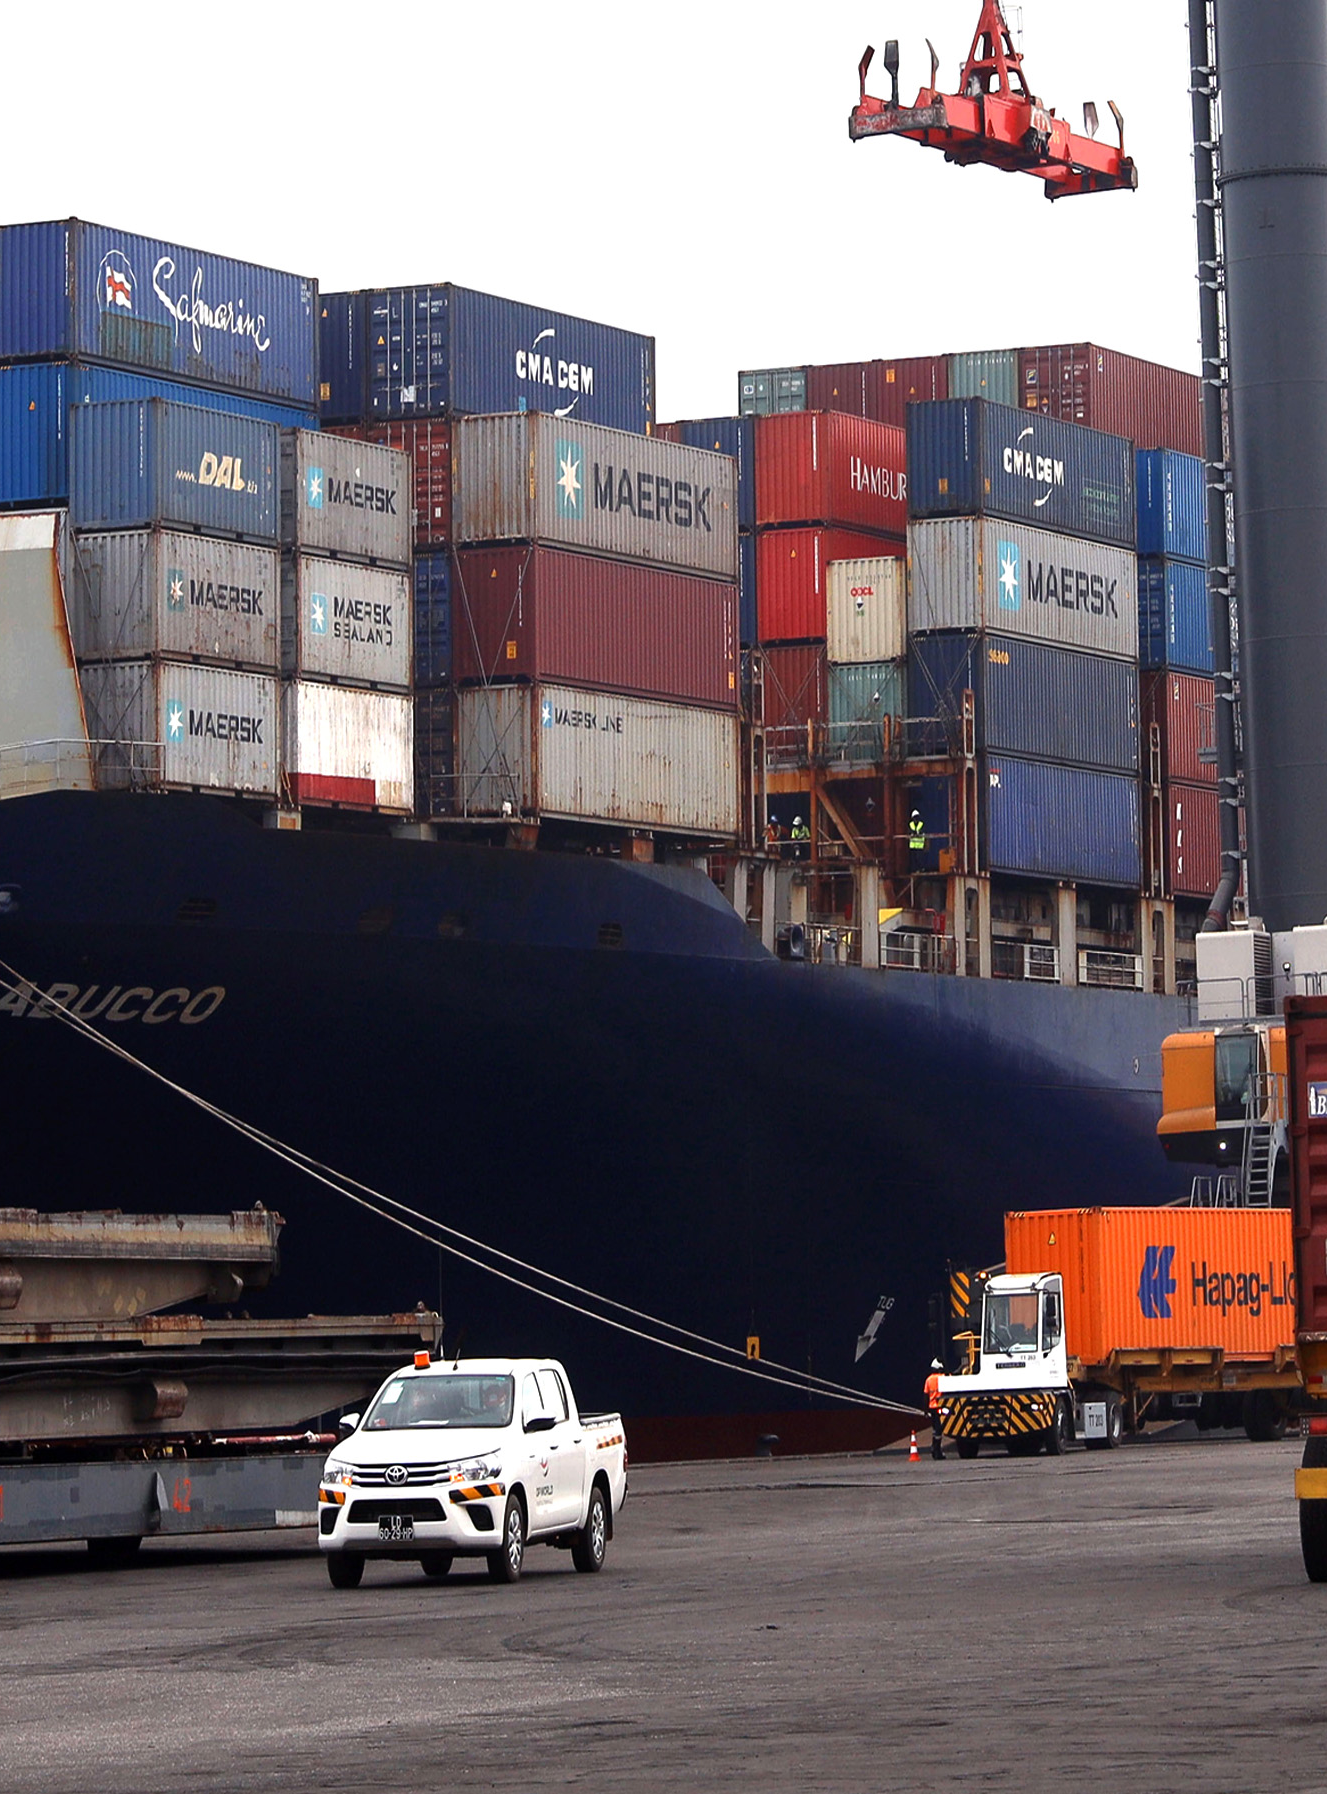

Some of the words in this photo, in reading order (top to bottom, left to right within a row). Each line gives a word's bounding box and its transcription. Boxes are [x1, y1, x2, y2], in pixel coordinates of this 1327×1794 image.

[153, 257, 270, 354] Safmarine
[515, 350, 554, 387] CMA
[558, 359, 594, 396] CGM
[198, 451, 245, 491] DAL
[1003, 447, 1034, 479] CMA
[1036, 456, 1065, 487] CGM
[328, 477, 397, 515] MAERSK
[593, 462, 712, 532] MAERSK
[190, 580, 264, 615] MAERSK
[1027, 560, 1118, 619] MAERSK
[334, 597, 392, 626] MAERSK
[334, 622, 392, 646] SEALAND
[189, 709, 264, 744] MAERSK
[877, 1295, 895, 1310] TUG
[391, 1515, 401, 1529] LD
